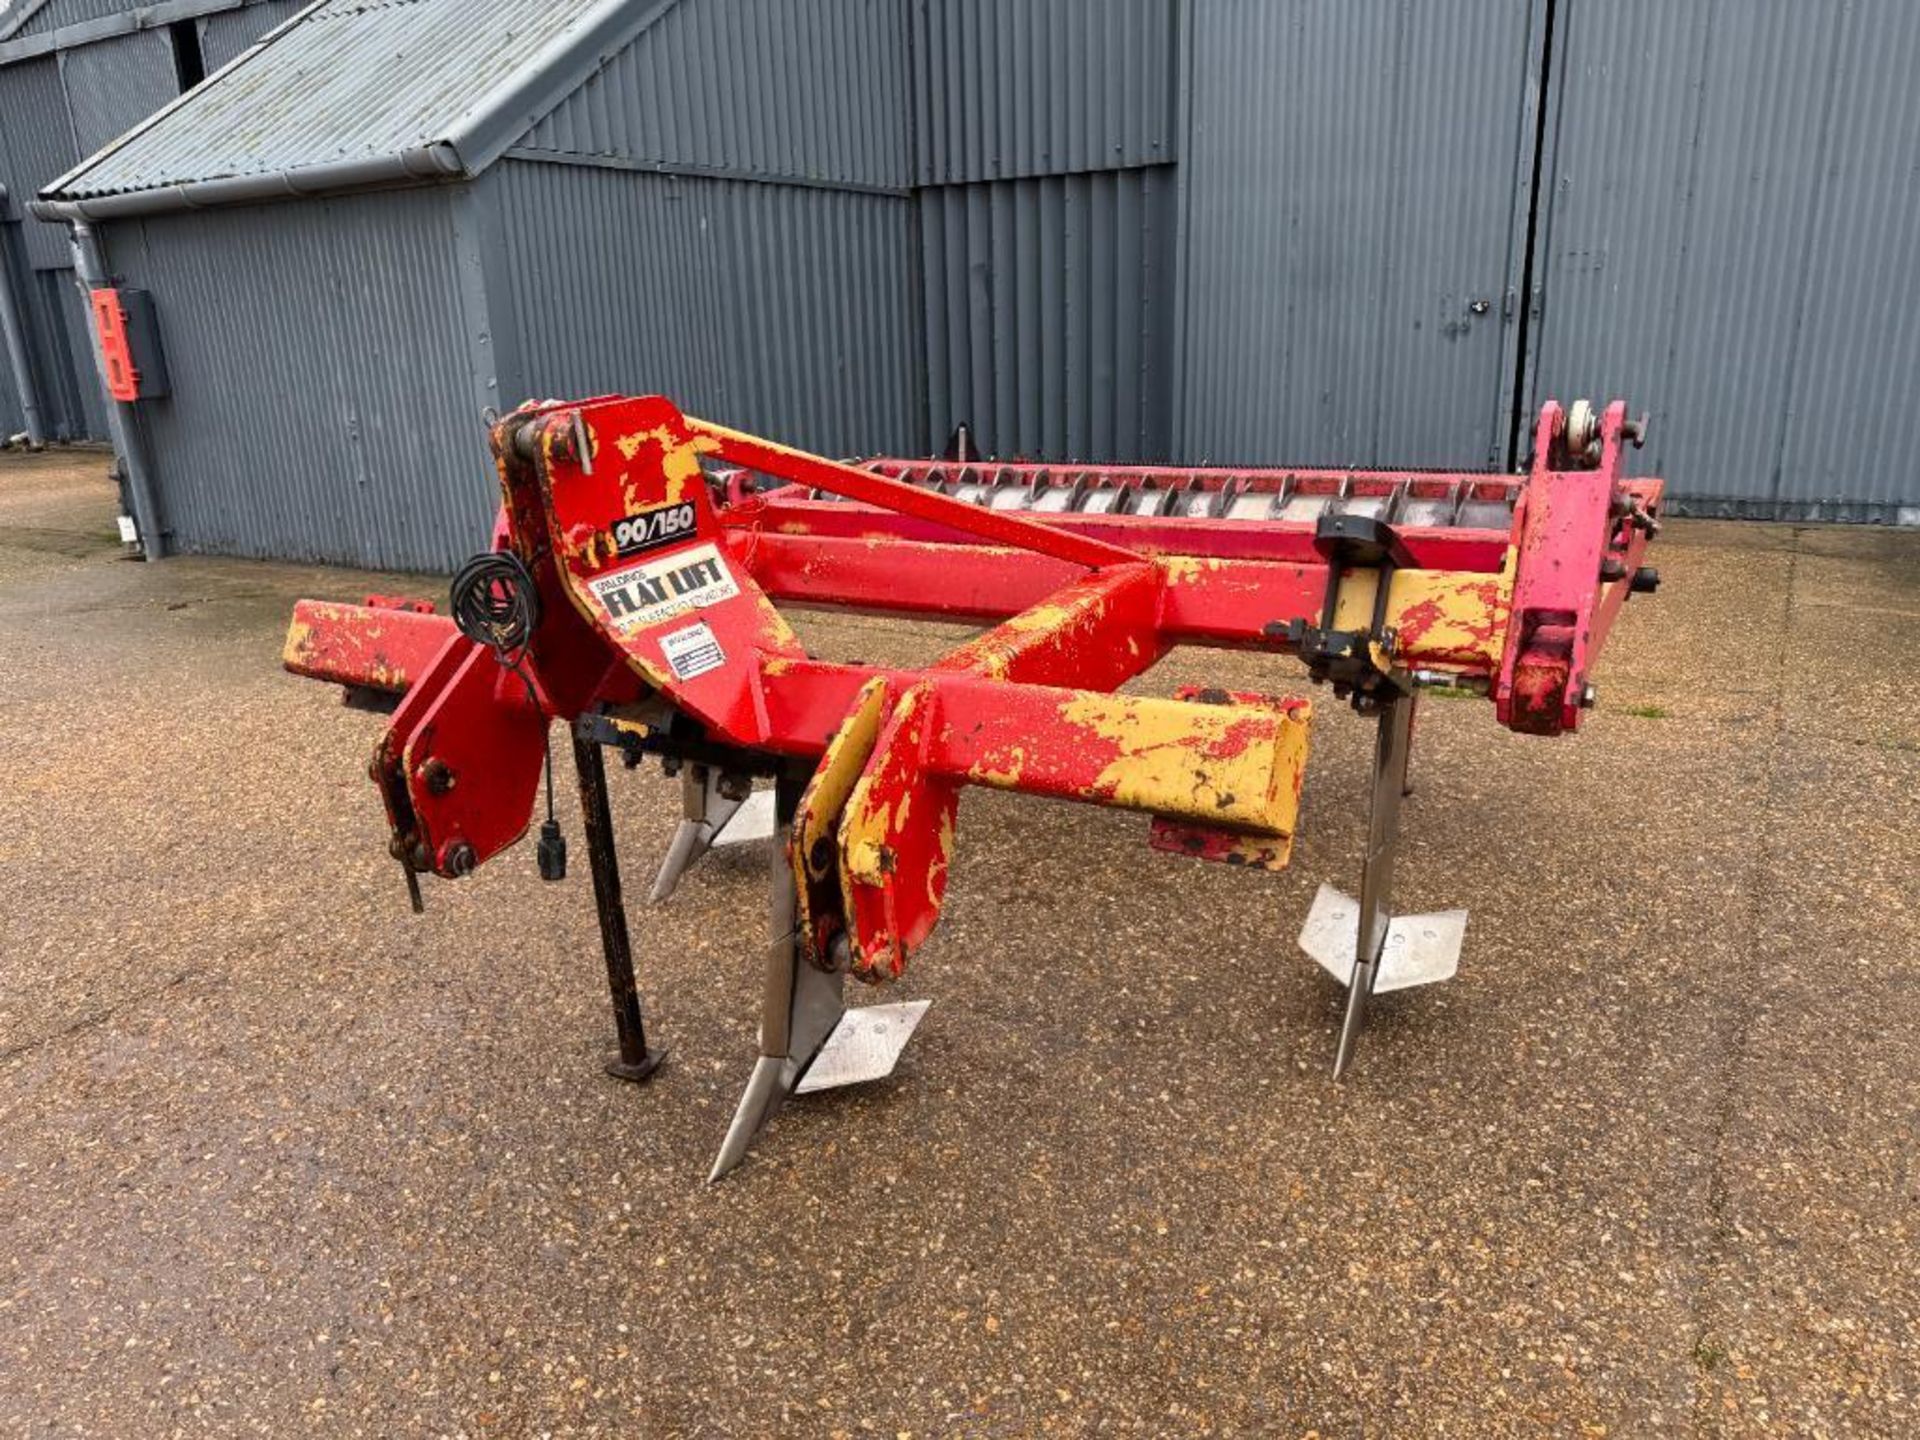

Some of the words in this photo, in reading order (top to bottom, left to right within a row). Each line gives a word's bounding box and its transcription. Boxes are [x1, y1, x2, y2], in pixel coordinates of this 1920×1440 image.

[616, 505, 694, 547] 90/150
[602, 576, 669, 618] FLAT
[667, 557, 723, 597] LIFT
